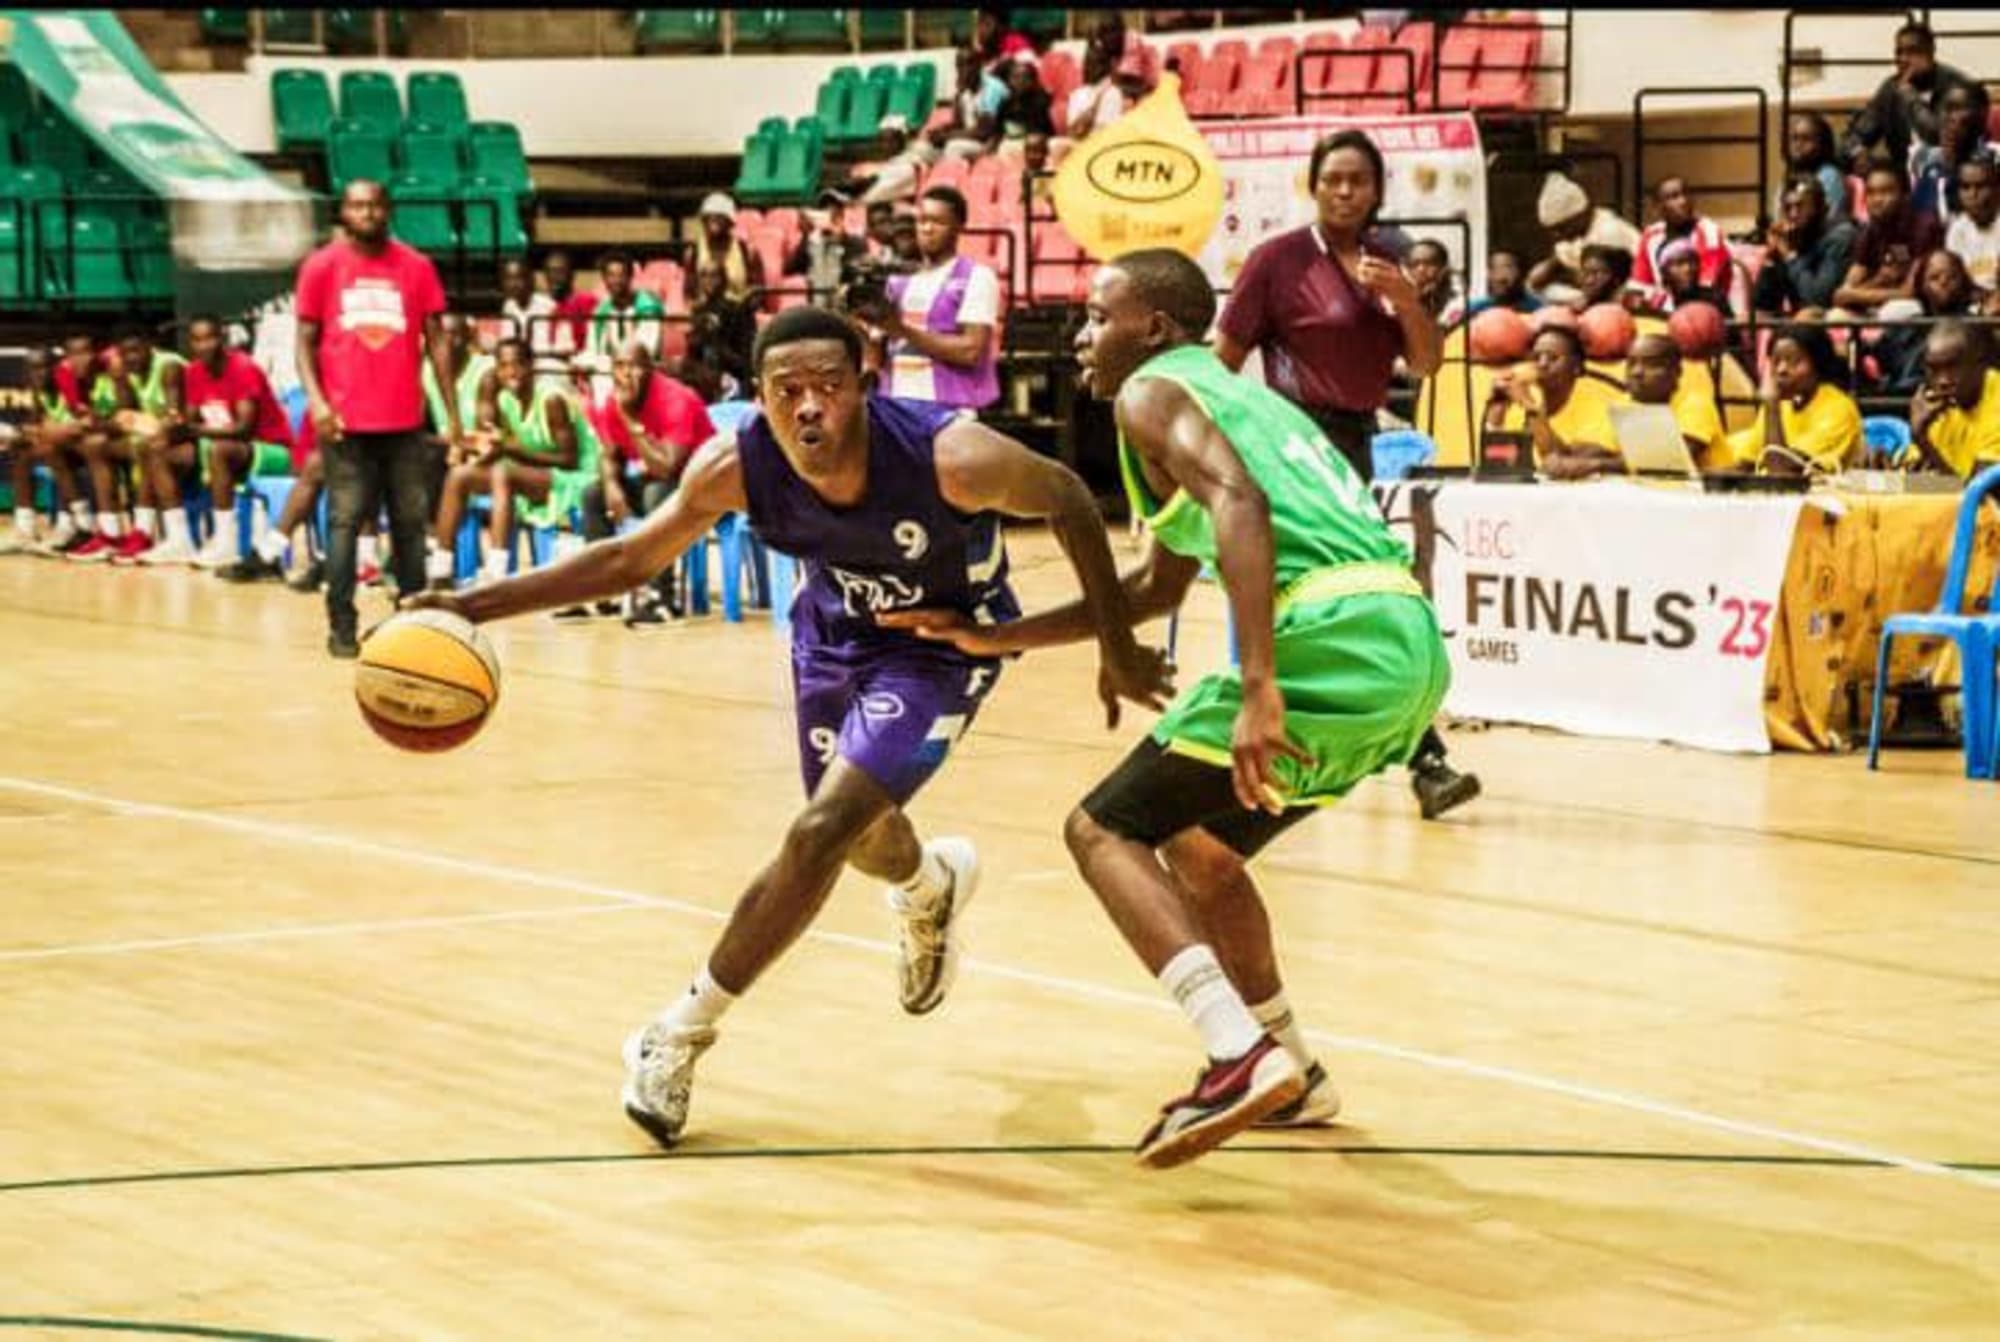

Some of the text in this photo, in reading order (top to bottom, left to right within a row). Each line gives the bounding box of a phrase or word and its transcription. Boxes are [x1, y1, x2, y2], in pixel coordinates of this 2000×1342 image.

[1114, 158, 1175, 185] MTN
[892, 519, 929, 560] 9
[1463, 517, 1515, 560] LBC
[1465, 571, 1697, 649] FINALS
[1466, 636, 1519, 665] GAMES
[809, 727, 836, 764] 9
